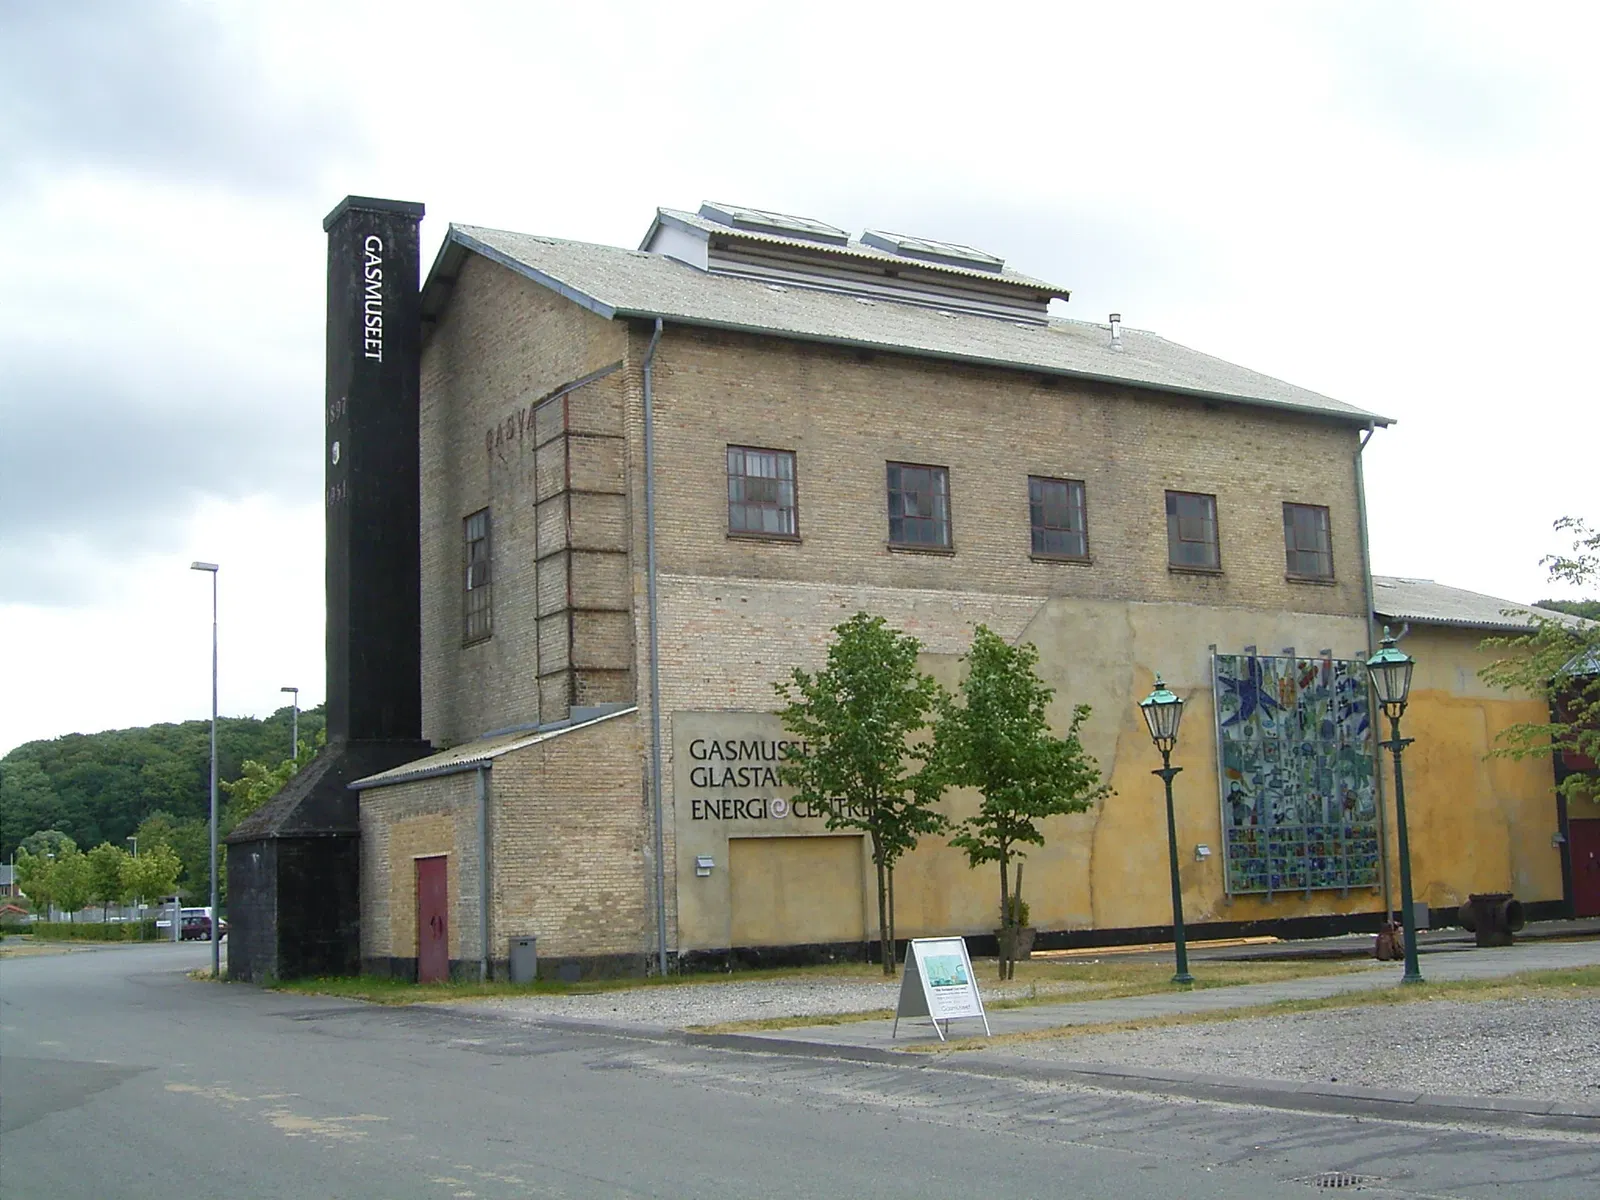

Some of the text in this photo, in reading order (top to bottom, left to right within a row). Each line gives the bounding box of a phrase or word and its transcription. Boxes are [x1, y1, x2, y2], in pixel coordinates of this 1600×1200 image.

[364, 235, 383, 362] GASMUSEET
[689, 739, 814, 761] GASMUSE
[692, 798, 877, 820] ENERGI CETRE
